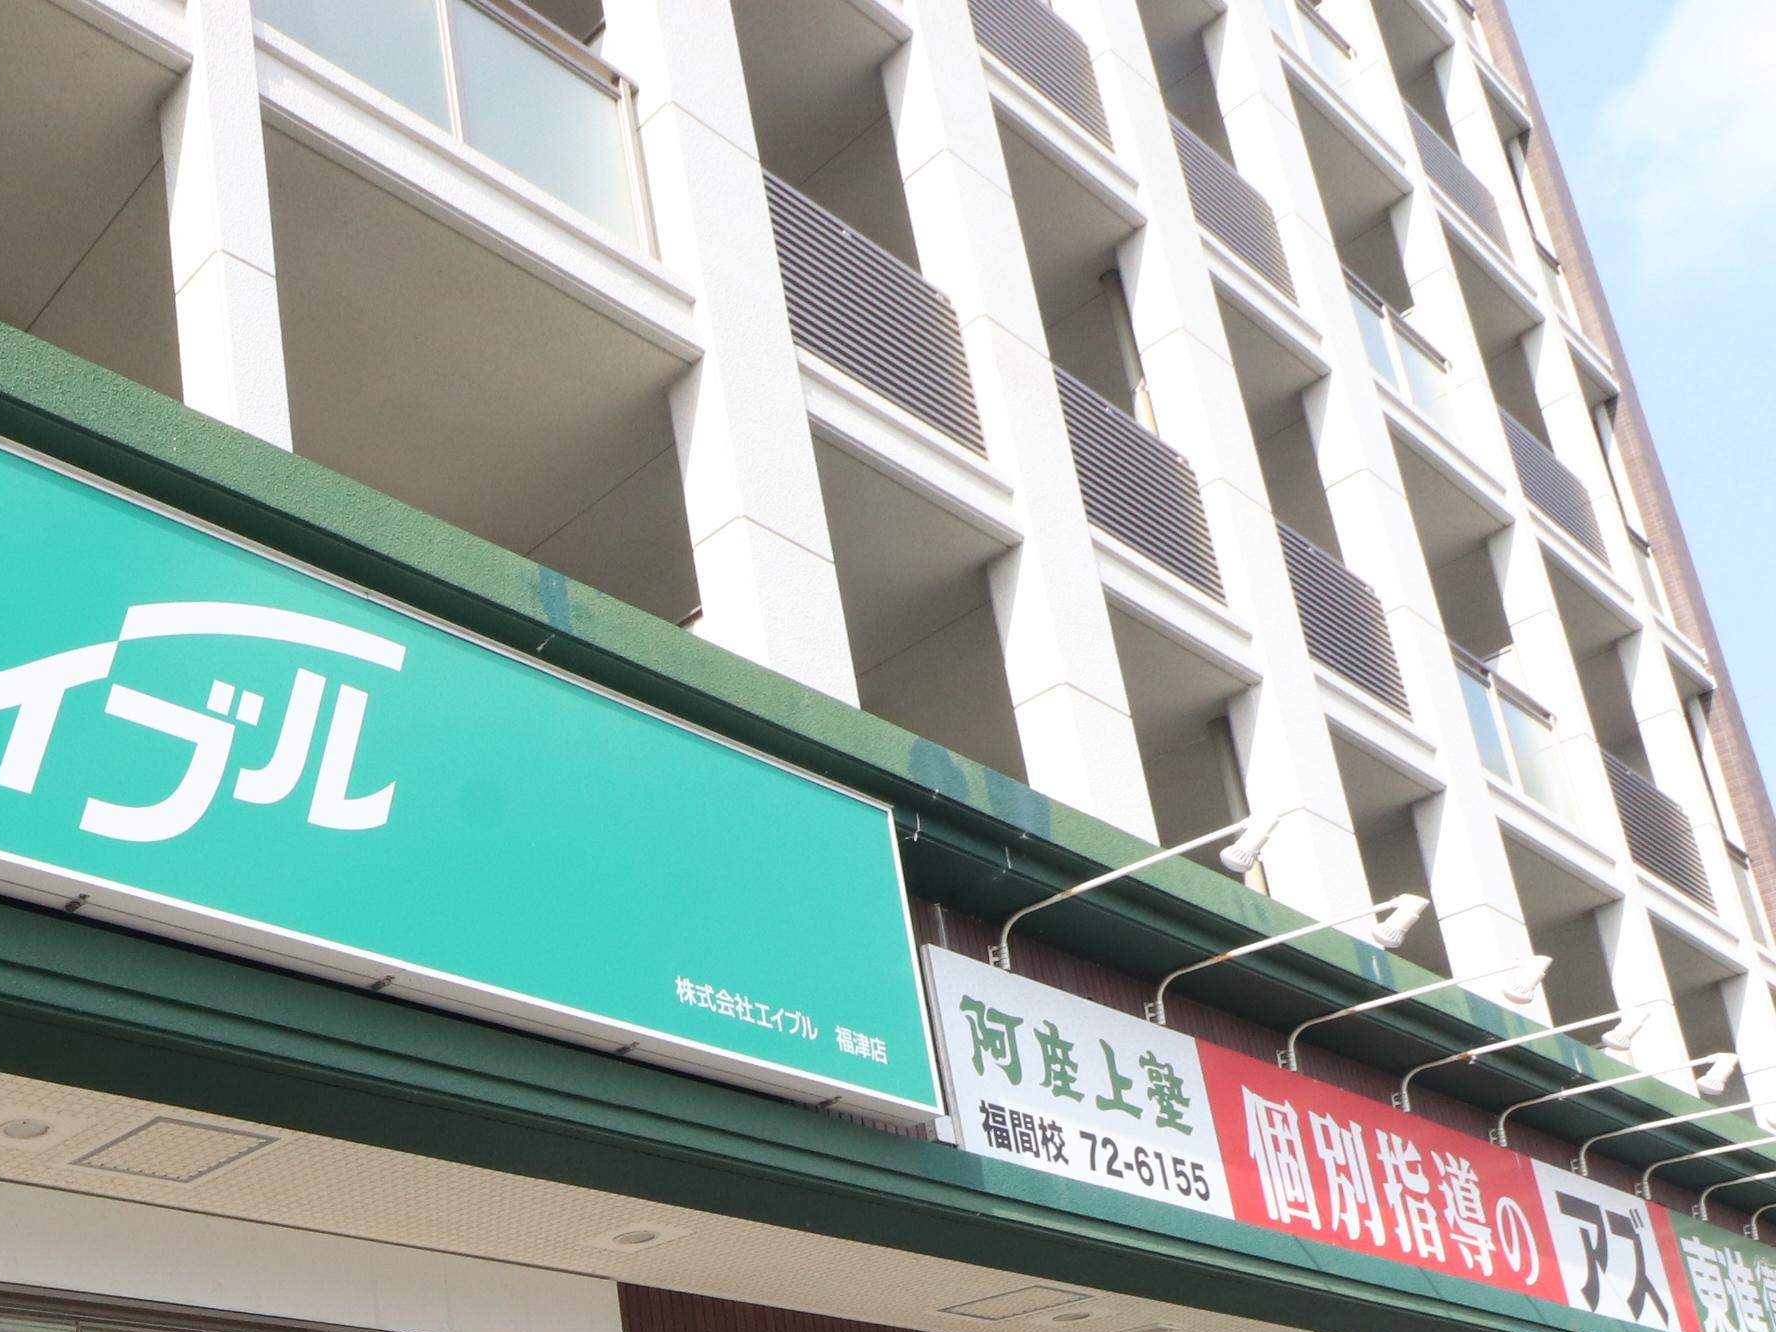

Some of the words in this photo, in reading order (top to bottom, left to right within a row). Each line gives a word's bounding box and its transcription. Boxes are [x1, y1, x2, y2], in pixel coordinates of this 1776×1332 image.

[675, 976, 818, 1041] 株式会社エイブル
[834, 1025, 889, 1065] 福津店
[978, 1100, 1070, 1168] 福間校
[1079, 1131, 1211, 1202] 72-6155
